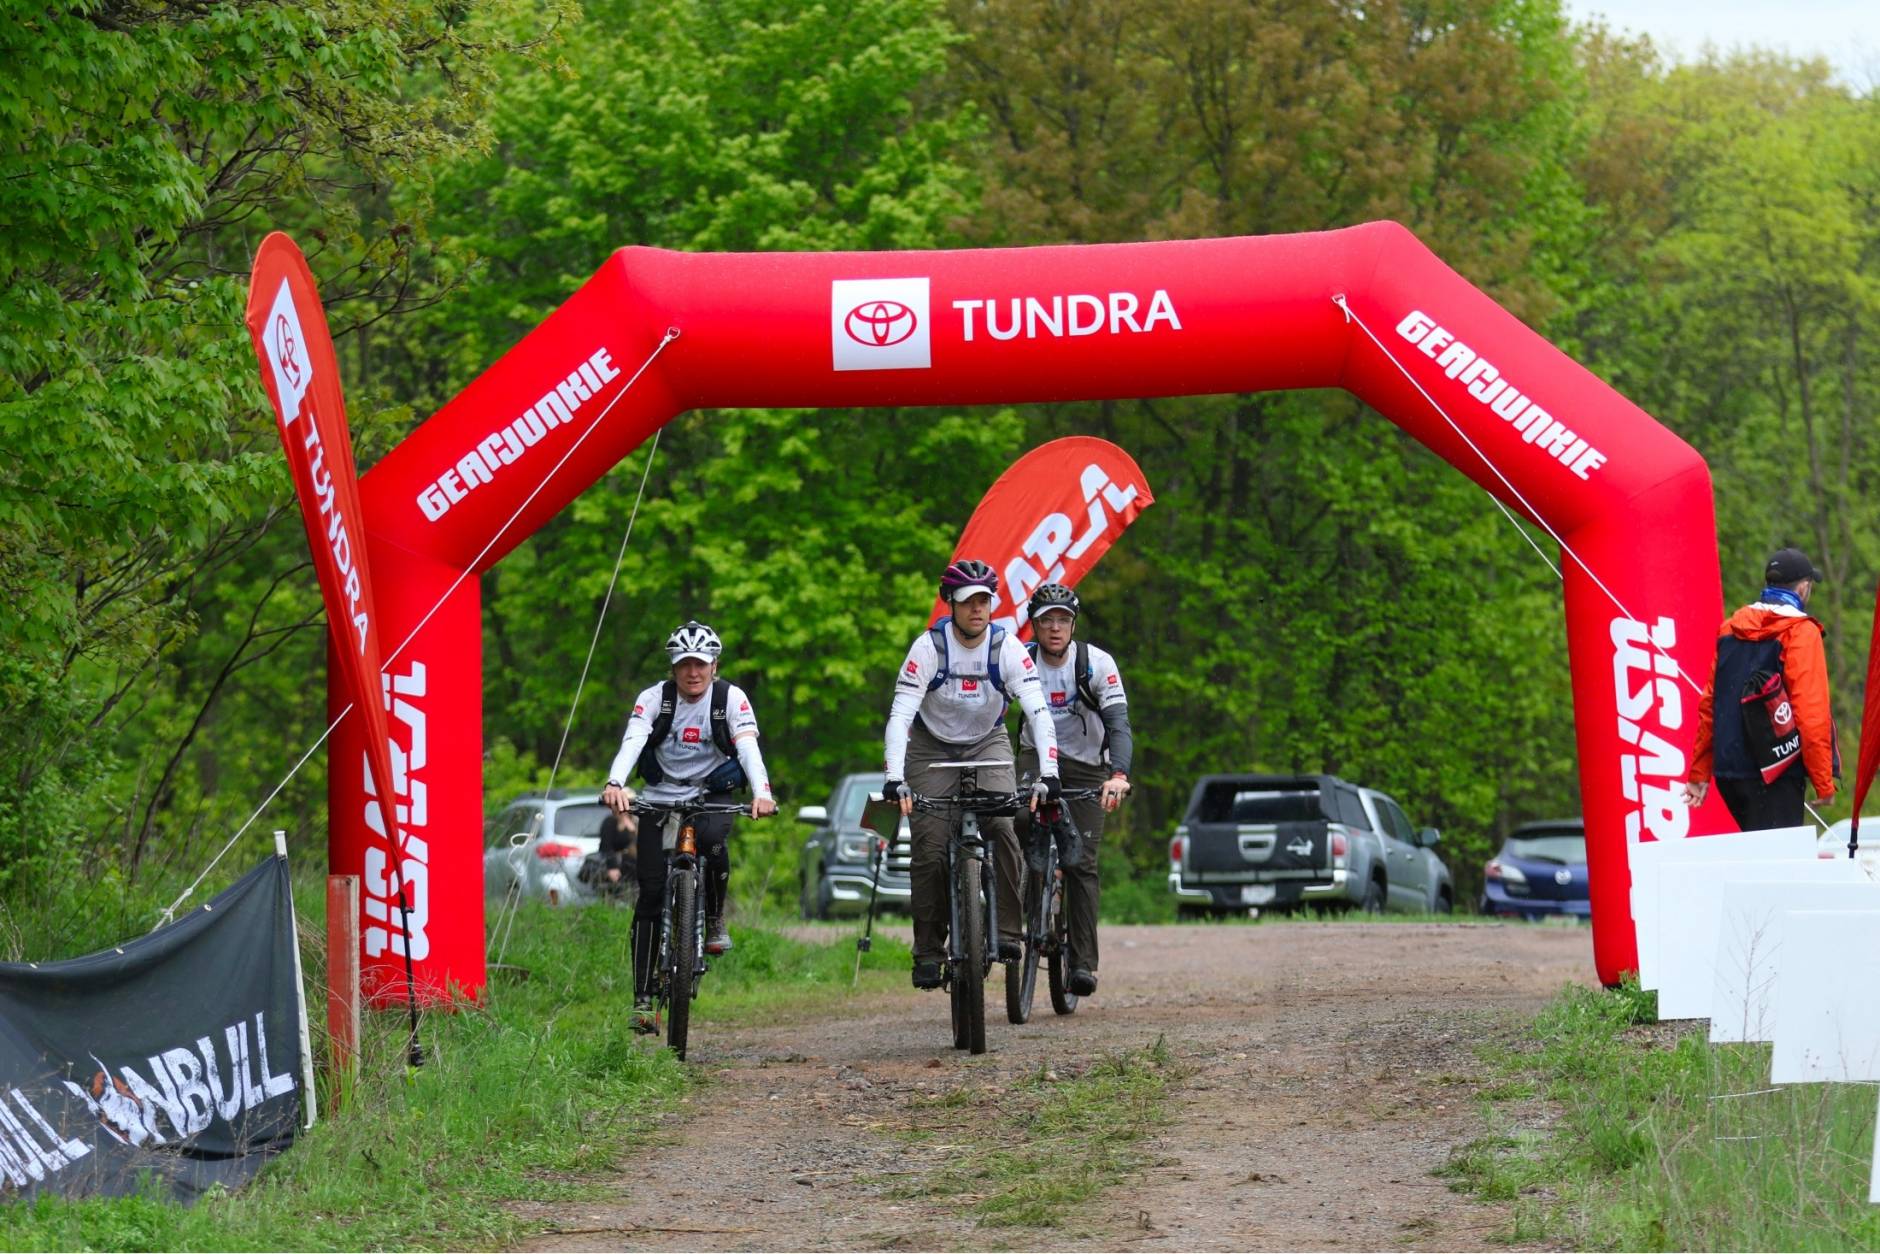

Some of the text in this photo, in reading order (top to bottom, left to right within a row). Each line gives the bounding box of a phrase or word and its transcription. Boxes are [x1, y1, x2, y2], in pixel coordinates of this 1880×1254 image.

[952, 289, 1183, 342] TUNDRA
[1395, 310, 1608, 481] GEARJUNKIE
[416, 347, 621, 523] GEARJUNKIE
[303, 412, 369, 657] TUNDRA
[992, 464, 1138, 634] ARA
[1609, 615, 1691, 846] USAR
